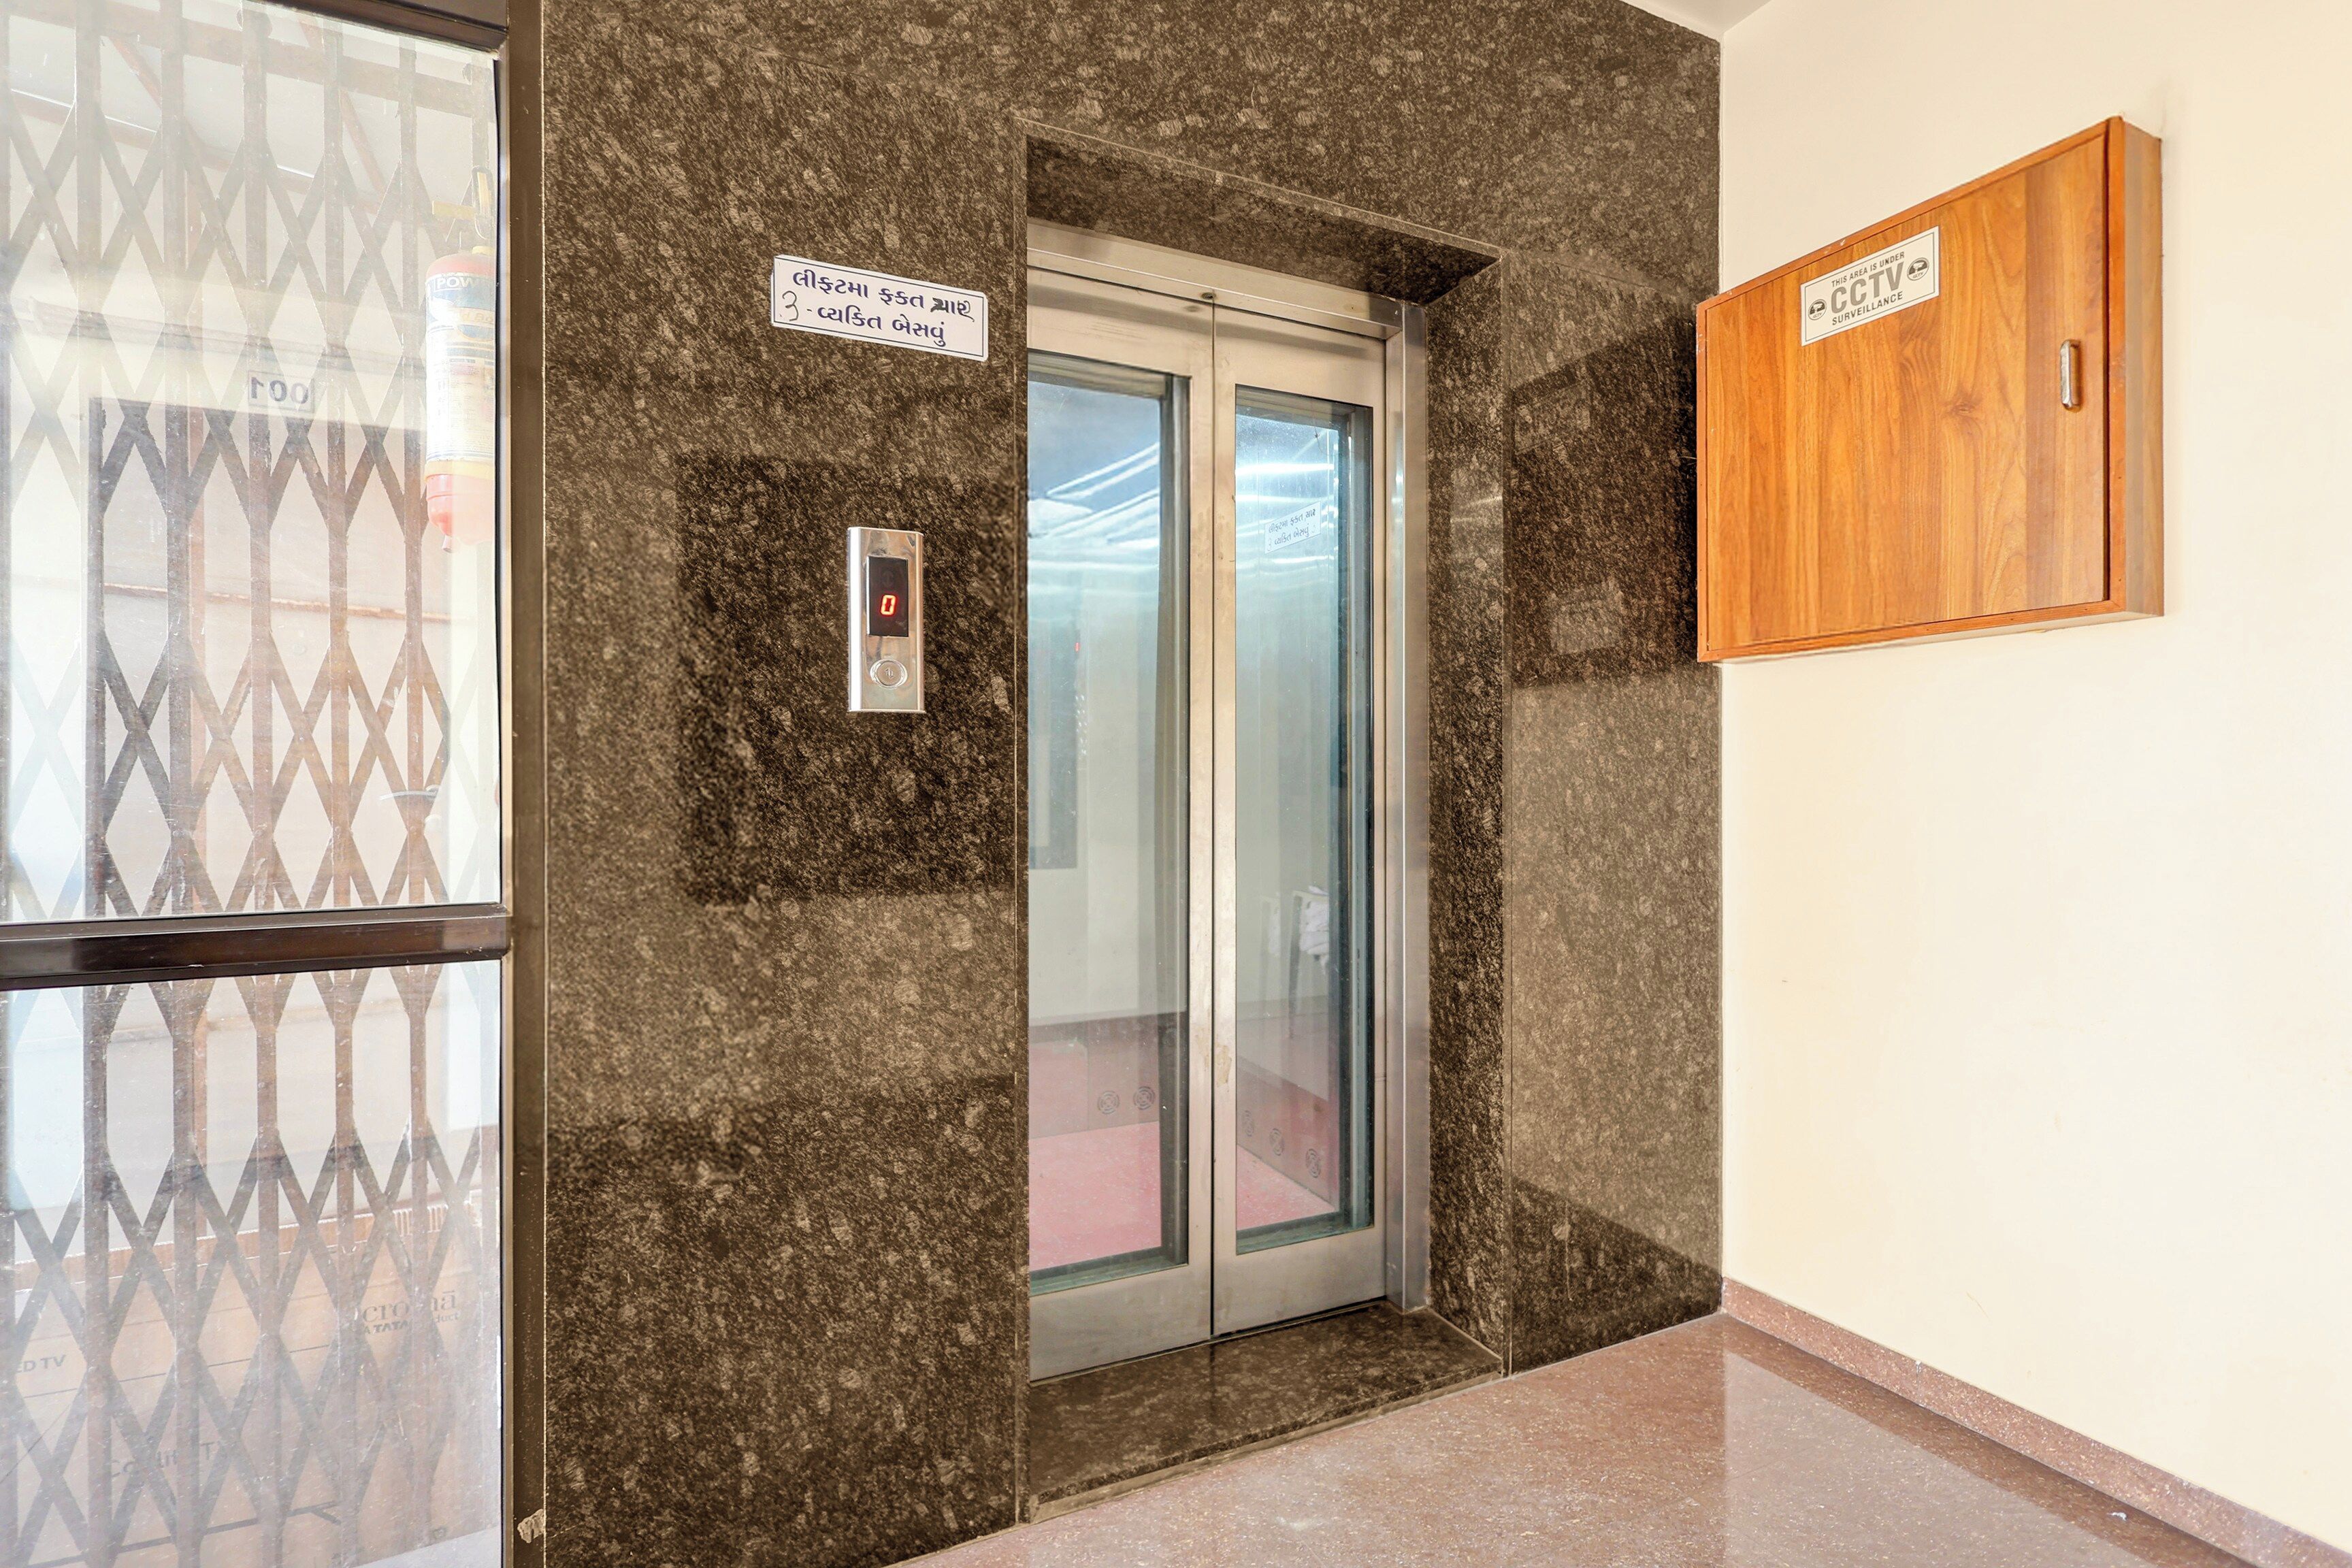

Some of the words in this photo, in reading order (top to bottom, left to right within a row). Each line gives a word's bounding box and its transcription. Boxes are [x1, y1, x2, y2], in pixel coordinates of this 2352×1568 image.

[1831, 275, 1847, 288] THIS
[1849, 266, 1868, 283] AREA
[1870, 262, 1878, 272] IS
[1879, 250, 1905, 268] UNDER
[1831, 261, 1905, 314] CCTV
[1831, 291, 1904, 326] SURVEILLANCE
[880, 594, 896, 615] 0
[40, 1354, 67, 1369] TV
